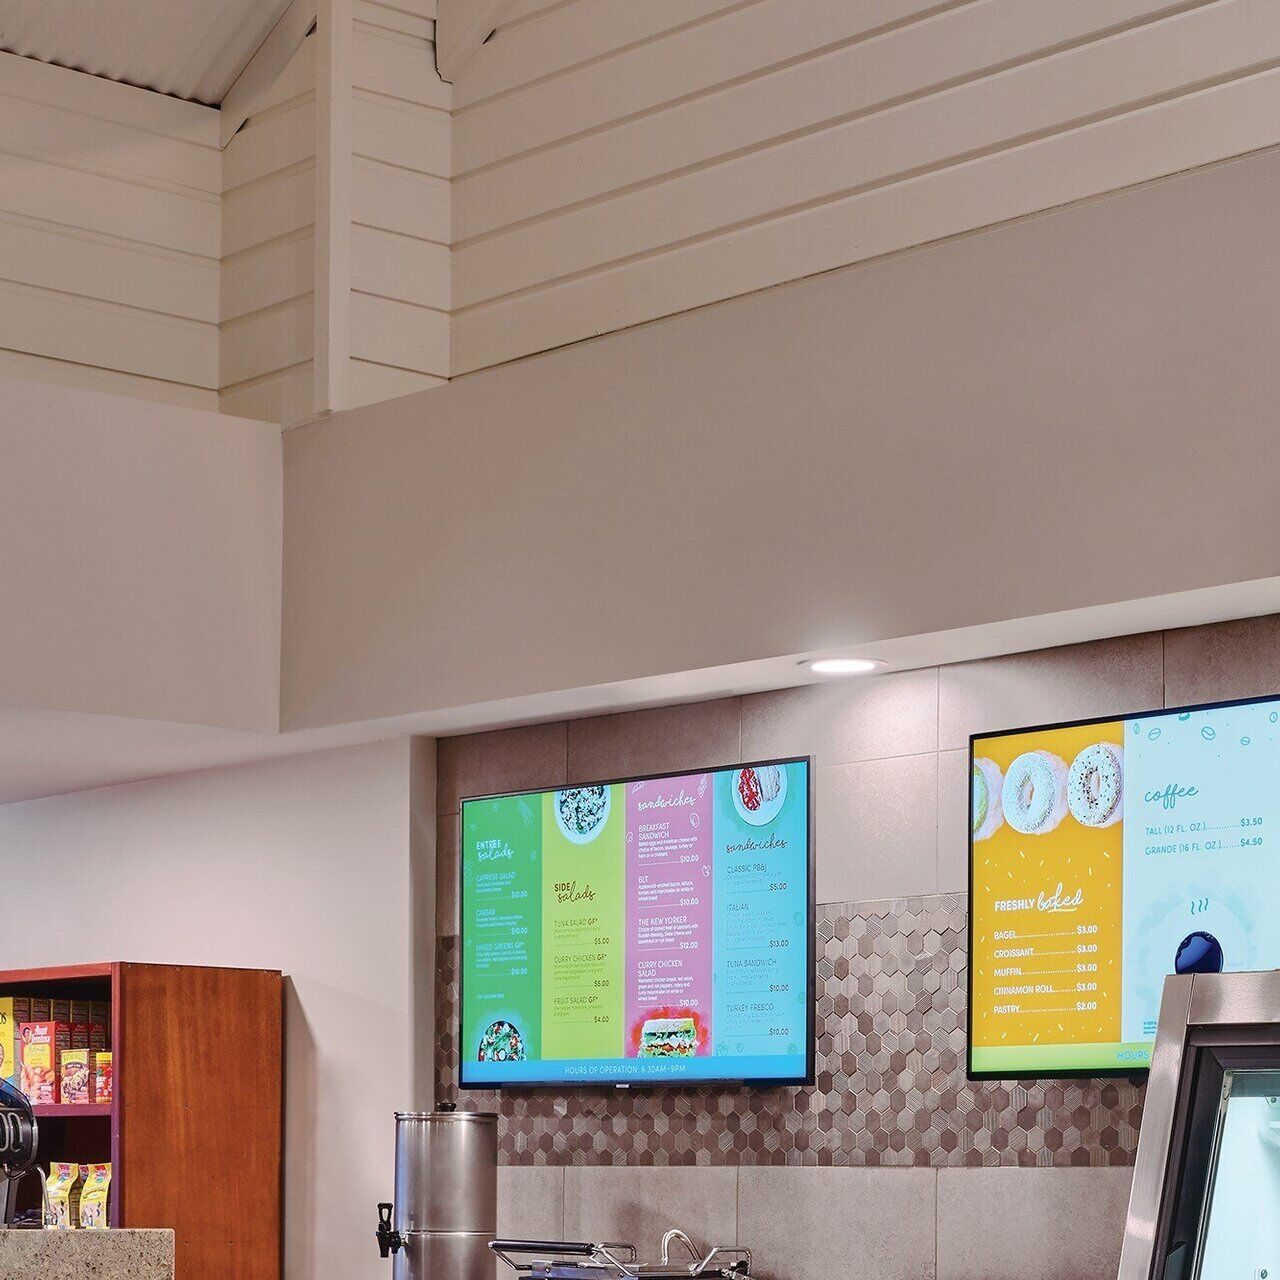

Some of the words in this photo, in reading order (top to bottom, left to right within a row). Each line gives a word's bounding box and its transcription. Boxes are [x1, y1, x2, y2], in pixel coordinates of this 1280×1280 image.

[637, 789, 696, 812] sandwiches
[1144, 783, 1200, 810] coffee
[638, 822, 670, 833] BREAKFAST
[1145, 827, 1163, 836] TALL
[1164, 825, 1175, 836] (12
[1176, 824, 1188, 834] FL.
[1240, 816, 1263, 828] $3.50
[638, 831, 670, 841] SANDWICH
[726, 832, 788, 854] sandwiches
[1144, 844, 1177, 856] GRANDE
[1179, 842, 1190, 854] (16
[1191, 841, 1203, 852] FL.
[1240, 837, 1263, 848] $4.50
[680, 854, 700, 864] $10.00
[727, 865, 752, 874] CLASSIC
[638, 875, 649, 884] BLT
[554, 882, 571, 892] SIDE
[557, 880, 597, 904] salads
[769, 883, 788, 892] $5.00
[680, 897, 700, 907] $10.00
[993, 898, 1035, 912] FRESHLY
[1036, 881, 1085, 913] baked
[638, 918, 650, 927] THE
[650, 917, 664, 926] NEW
[664, 915, 688, 925] YORKER
[993, 930, 1017, 941] BAGEL
[1076, 924, 1098, 935] $3.00
[594, 937, 610, 945] $5.00
[679, 941, 699, 950] $12.00
[769, 939, 790, 949] $13.00
[993, 947, 1035, 959] CROISSANT
[1076, 943, 1098, 954] $3.00
[572, 954, 596, 962] CHICKEN
[744, 958, 777, 968] SANDWICH
[638, 961, 657, 970] CURRY
[658, 959, 684, 968] CHICKEN
[993, 967, 1022, 977] MUFFIN
[1076, 962, 1098, 973] $3.00
[638, 969, 657, 978] SALAD
[593, 979, 610, 988] $5.00
[769, 984, 790, 993] $10.00
[993, 985, 1034, 996] CINNAMON
[1035, 984, 1054, 995] ROLL
[1076, 982, 1098, 993] $3.00
[679, 998, 699, 1008] $10.00
[726, 1004, 749, 1012] TURKEY
[750, 1002, 775, 1012] FRESCO
[993, 1004, 1020, 1015] PASTRY
[1076, 1001, 1098, 1012] $2.00
[593, 1015, 610, 1024] $4.00
[768, 1027, 790, 1037] $10.00
[1117, 1050, 1150, 1061] HOURS
[564, 1066, 588, 1075] HOURS
[588, 1065, 599, 1074] OF
